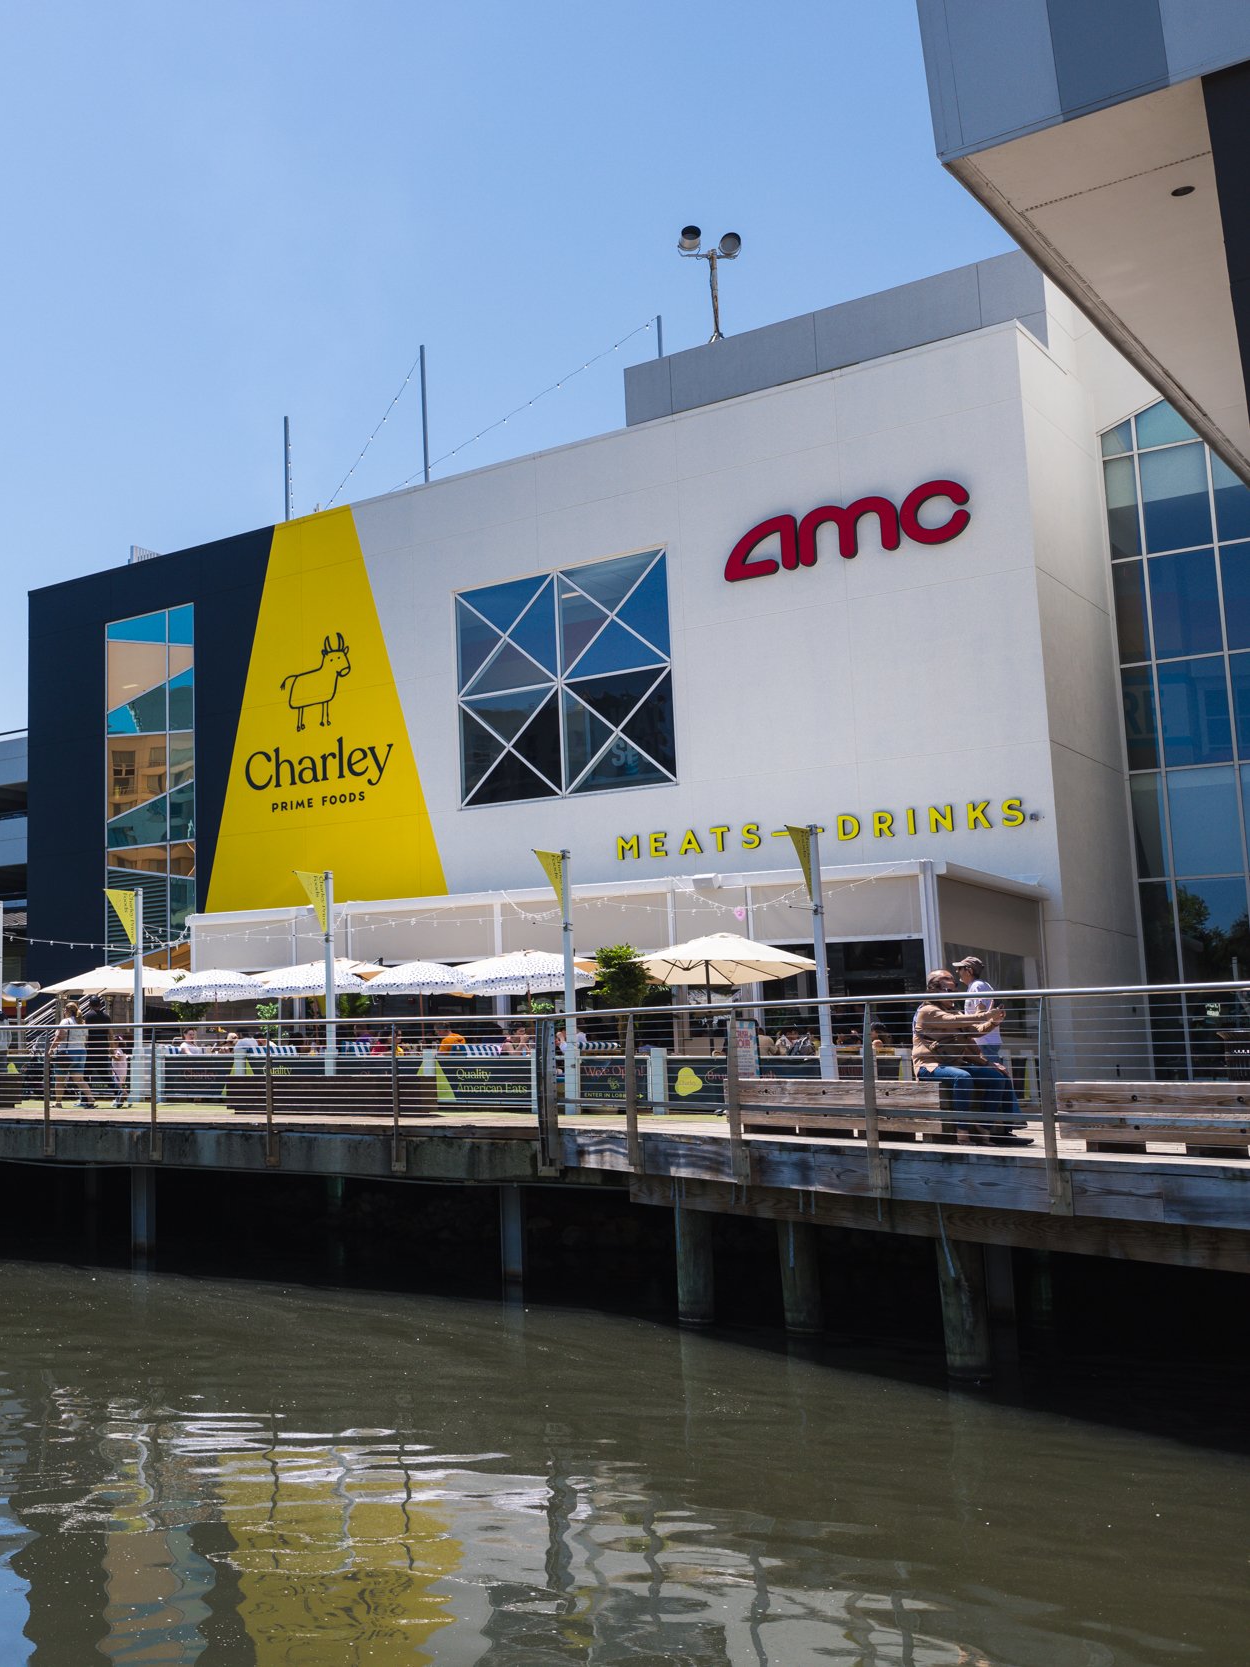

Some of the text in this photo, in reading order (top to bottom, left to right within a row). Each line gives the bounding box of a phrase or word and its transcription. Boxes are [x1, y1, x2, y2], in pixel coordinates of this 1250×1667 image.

[245, 736, 394, 791] Charley
[271, 791, 366, 813] PRIME FOODS
[616, 798, 1026, 861] MEATS DRINKS
[456, 1068, 491, 1081] Quality
[611, 1065, 645, 1079] Opn!
[457, 1082, 528, 1094] American Eats
